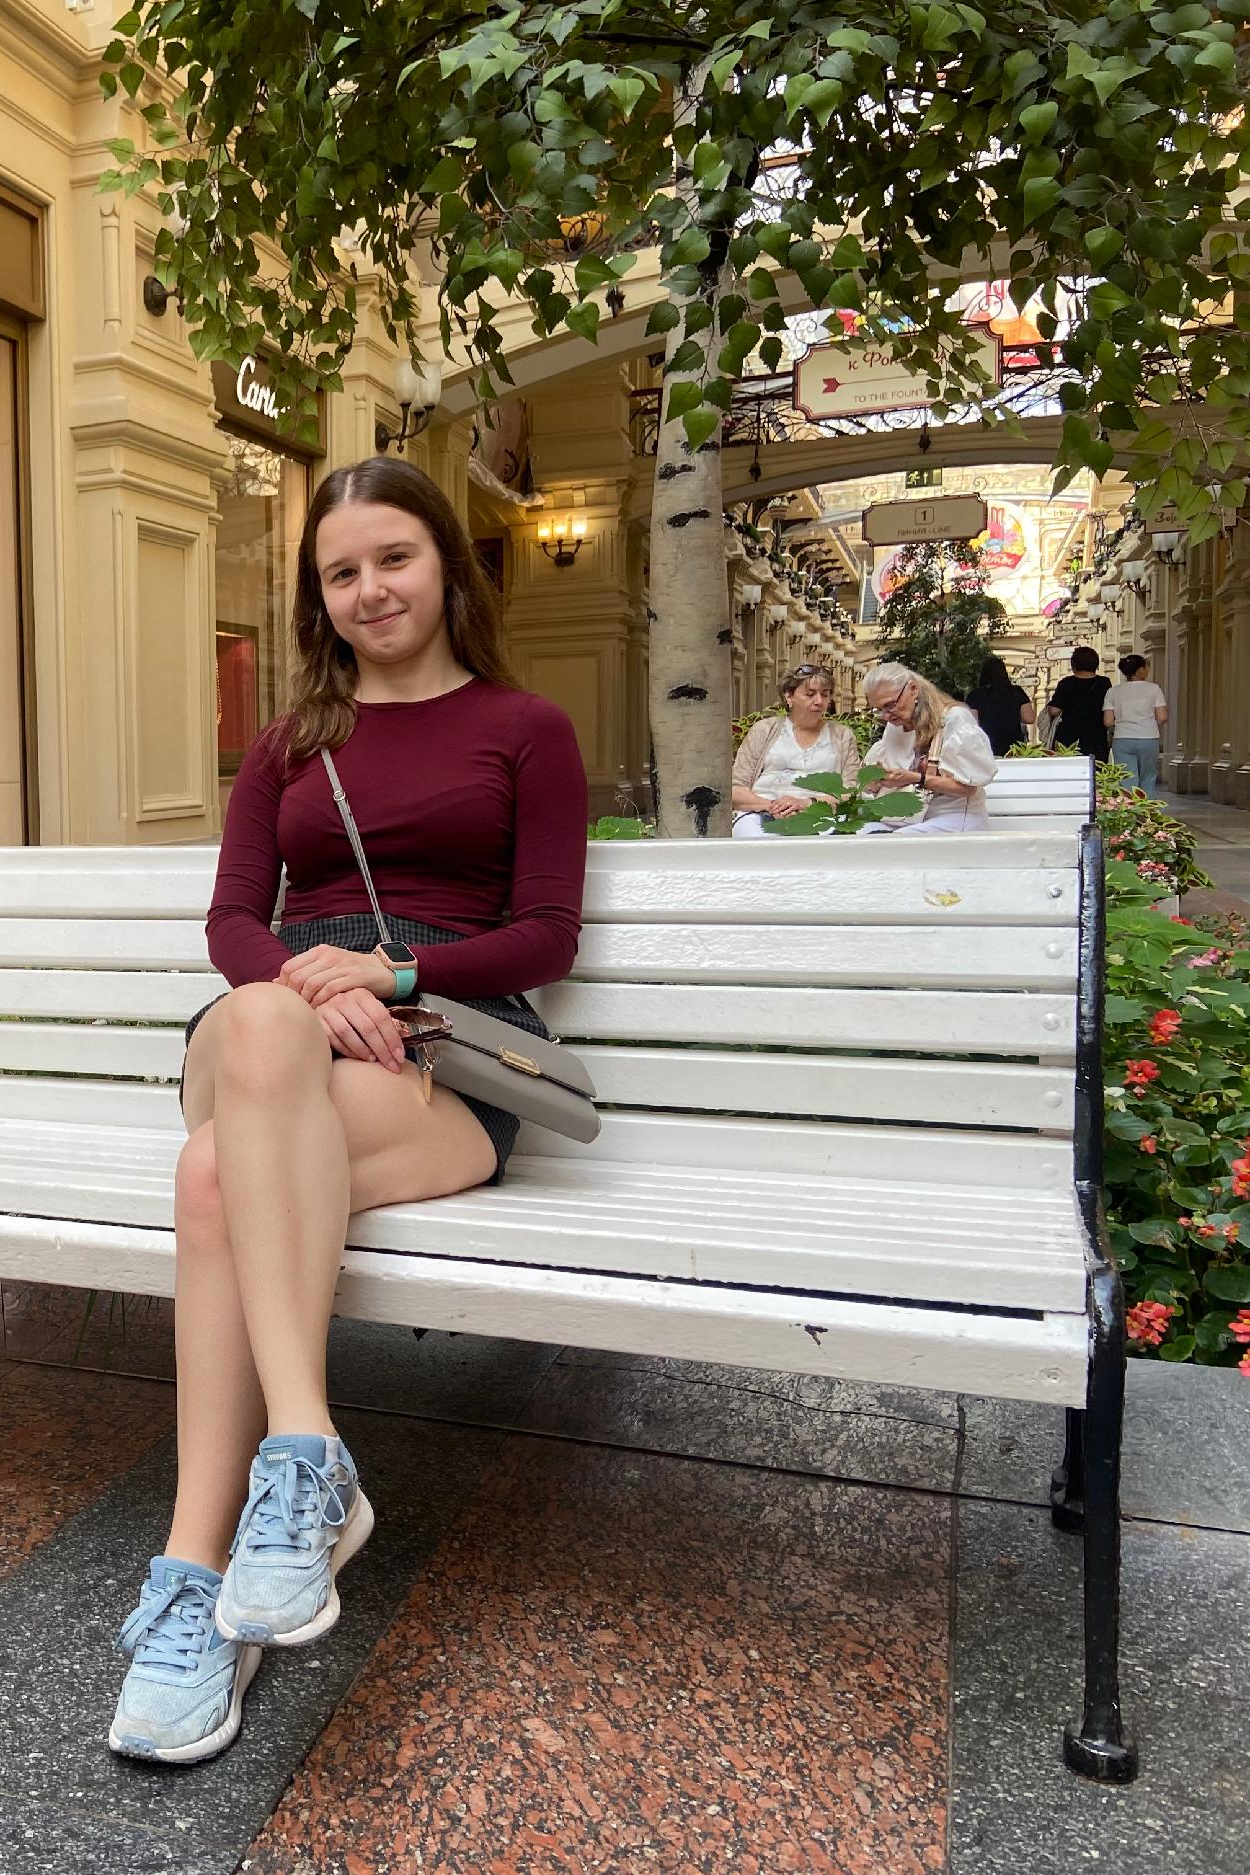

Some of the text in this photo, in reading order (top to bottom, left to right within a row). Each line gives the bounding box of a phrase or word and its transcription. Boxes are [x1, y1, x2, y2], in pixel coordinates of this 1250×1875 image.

[853, 394, 867, 403] TO
[868, 391, 888, 402] THE
[920, 510, 928, 521] 1
